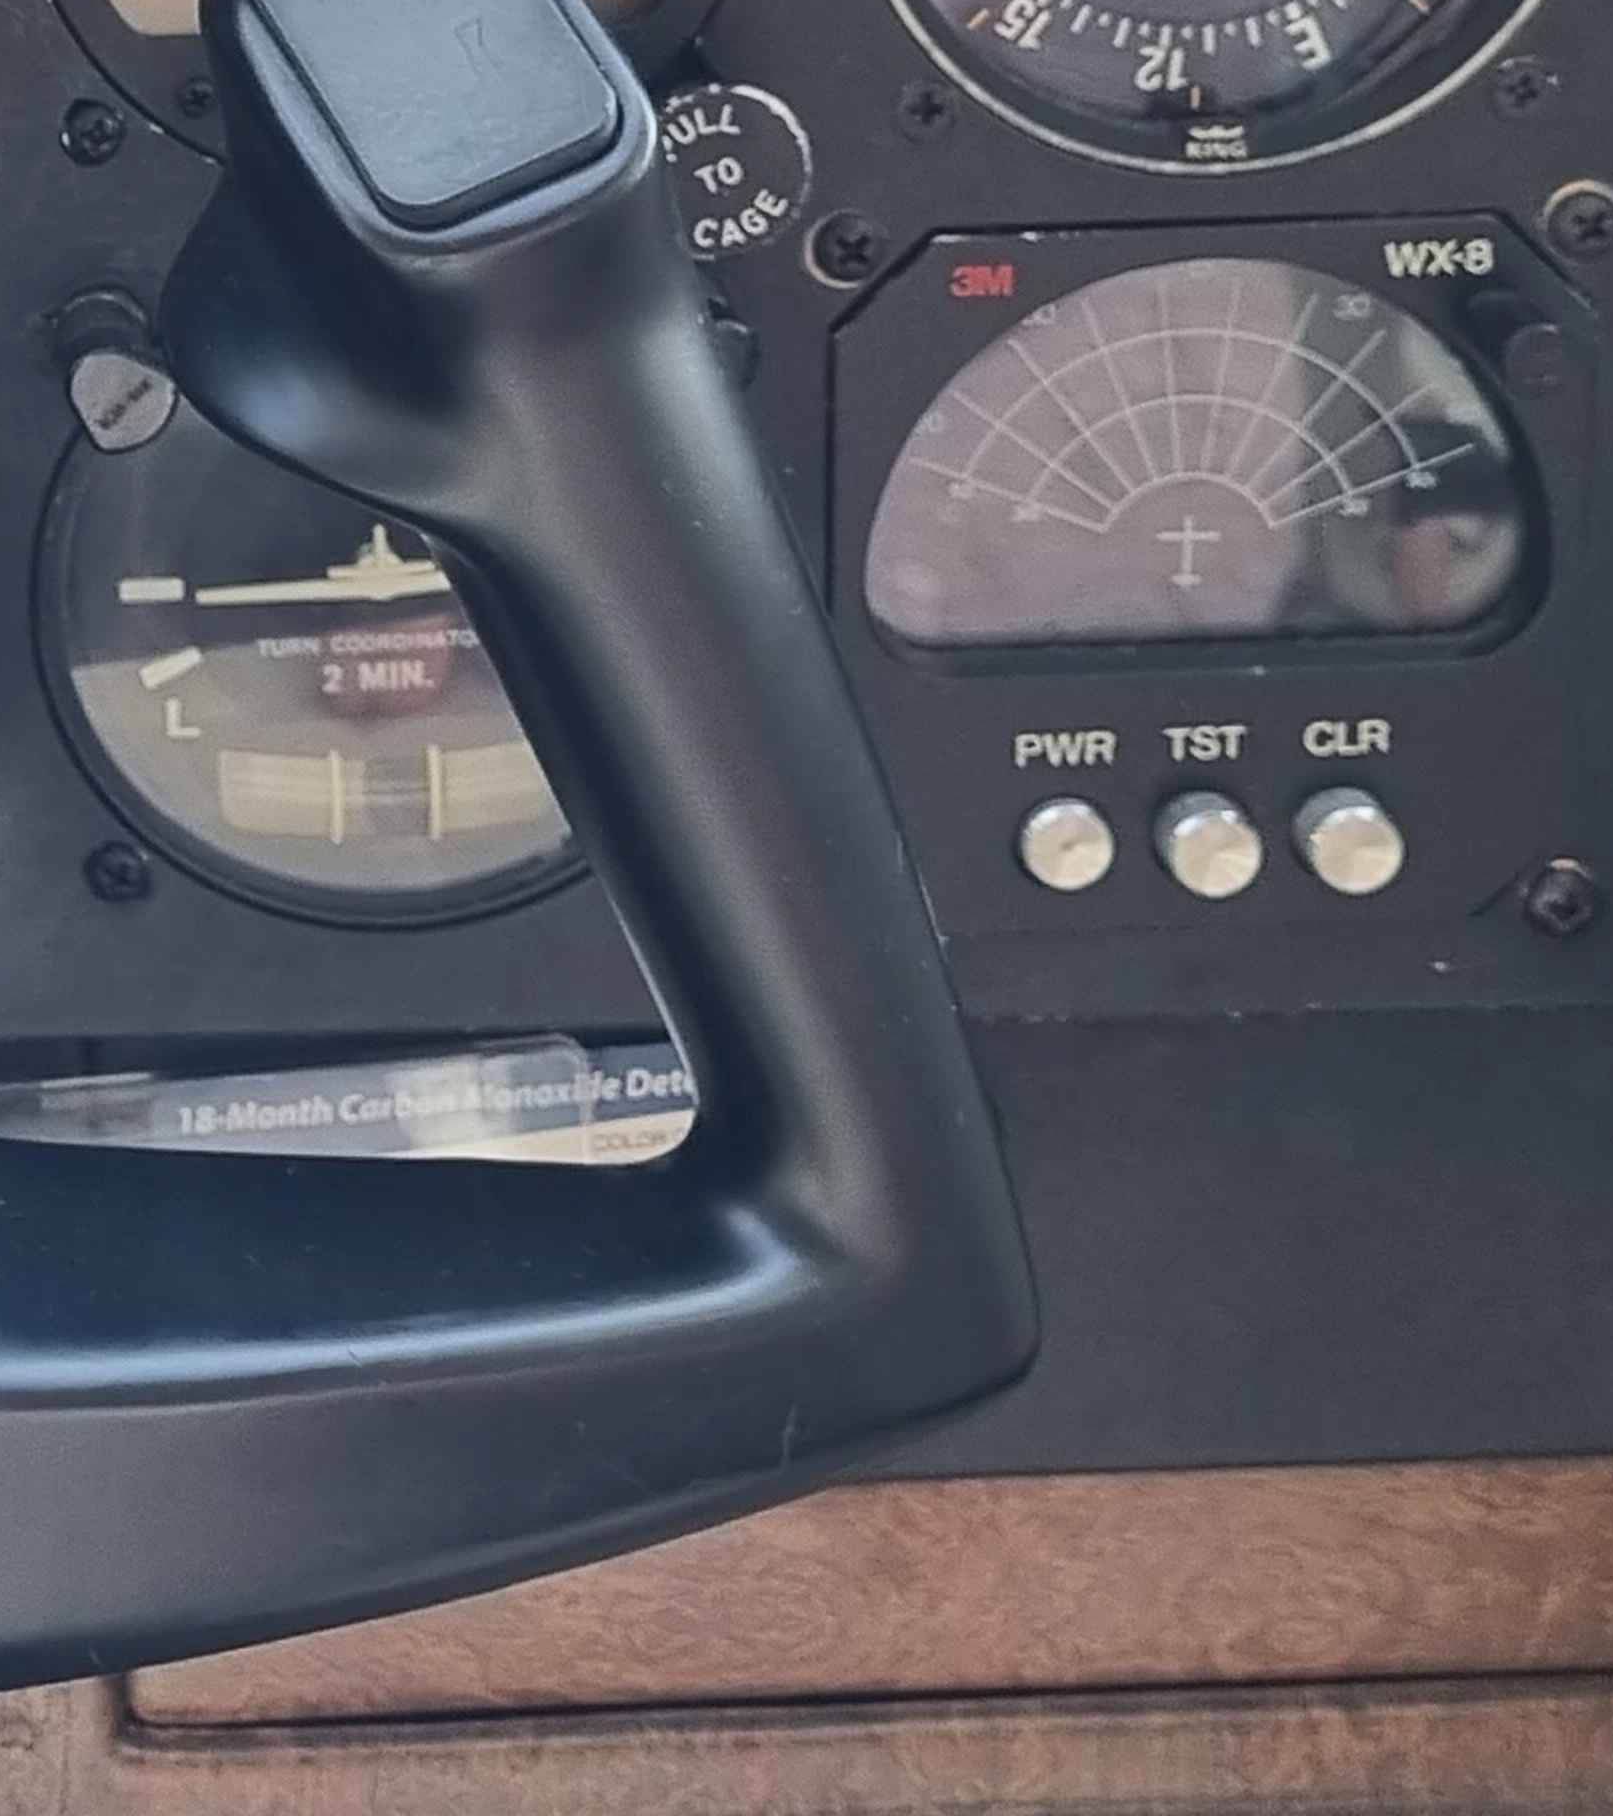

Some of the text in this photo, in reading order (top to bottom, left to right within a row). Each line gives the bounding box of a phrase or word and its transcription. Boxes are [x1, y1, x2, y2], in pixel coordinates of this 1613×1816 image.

[694, 157, 743, 194] TO
[693, 189, 789, 246] CAGE
[1384, 238, 1493, 277] WX-8
[950, 263, 1015, 296] 3M
[1014, 731, 1117, 767] PWR
[1164, 725, 1246, 761] TST
[1303, 719, 1391, 755] CLR
[178, 1094, 334, 1137] 18-Month
